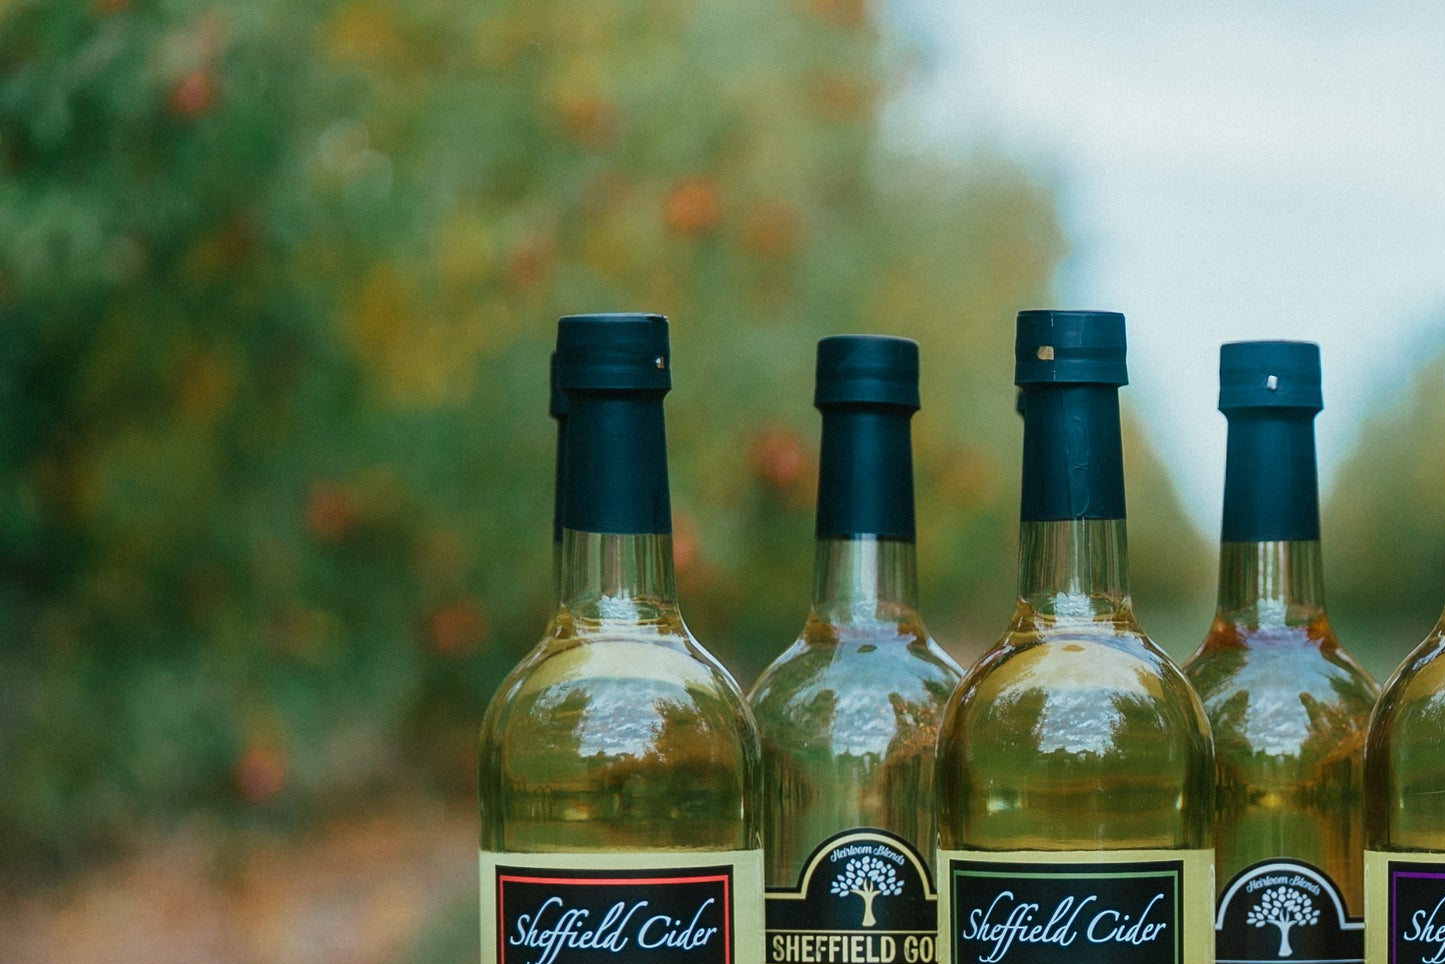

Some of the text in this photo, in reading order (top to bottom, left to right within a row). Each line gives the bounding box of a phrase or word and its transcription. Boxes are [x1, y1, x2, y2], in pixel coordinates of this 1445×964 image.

[830, 845, 905, 866] Heirloom Blends
[1246, 876, 1320, 896] Heirloom Blends
[638, 898, 717, 950] Cider
[963, 890, 1166, 963] Sheffield Cider
[772, 935, 896, 963] SHEFFIELD
